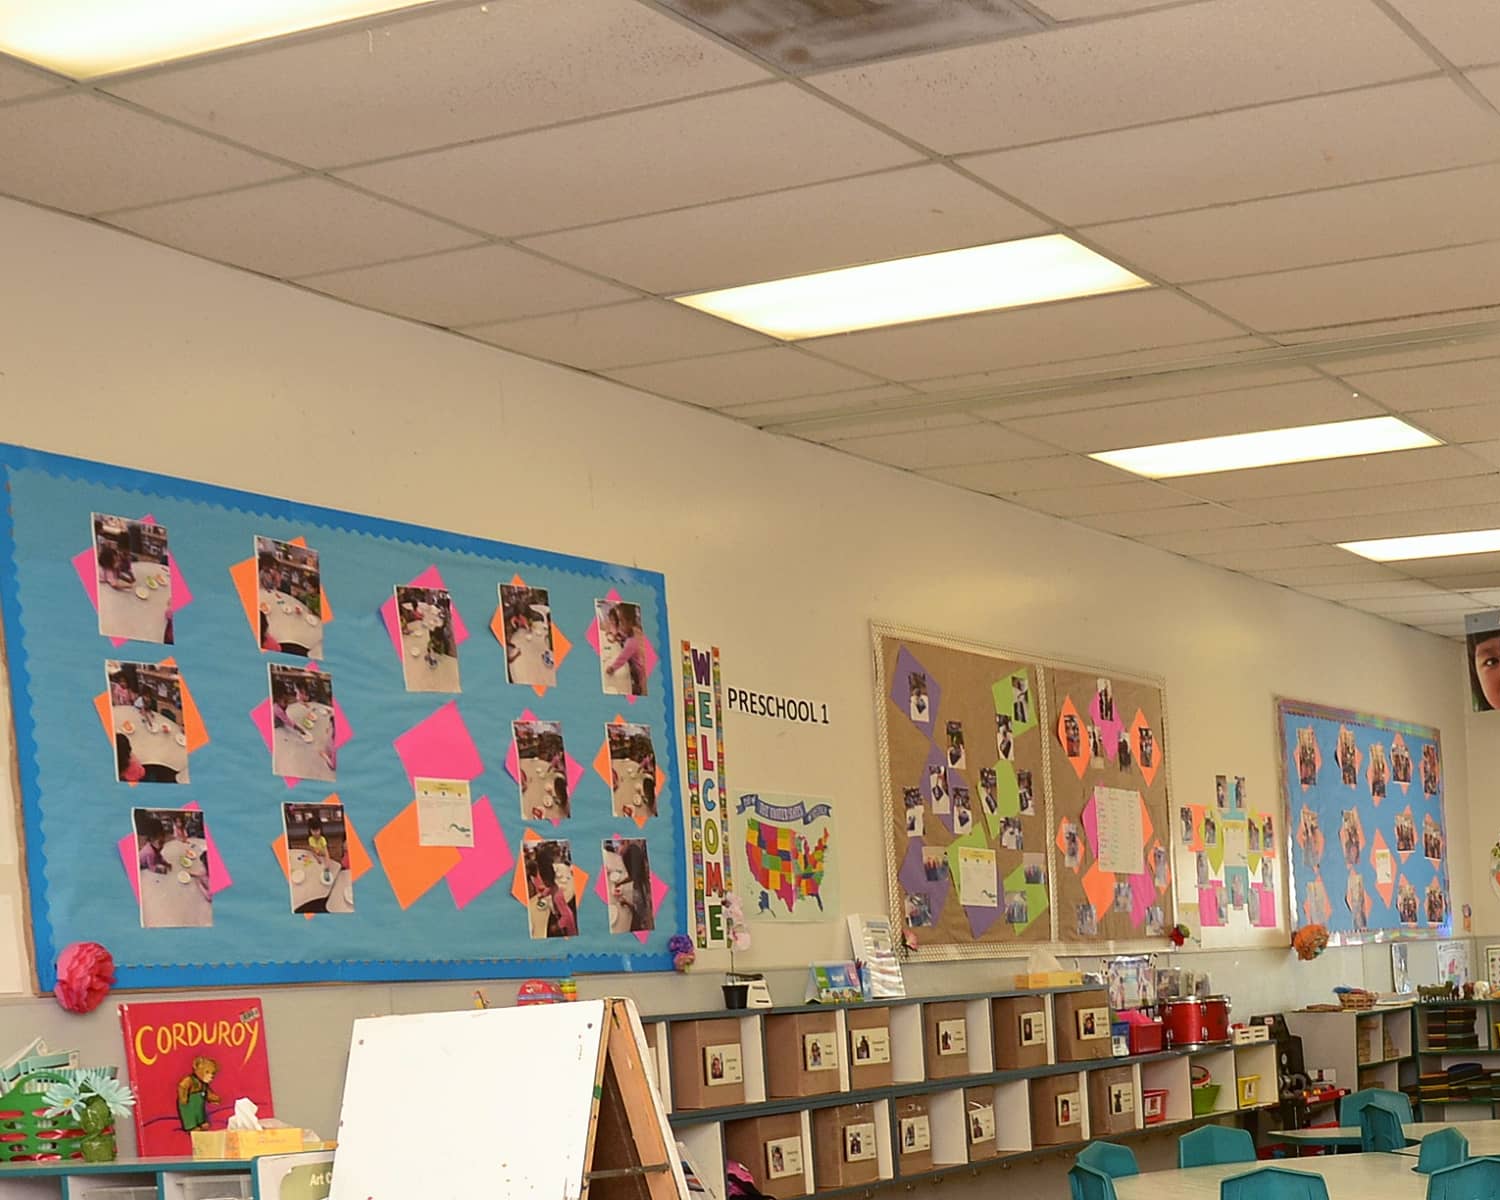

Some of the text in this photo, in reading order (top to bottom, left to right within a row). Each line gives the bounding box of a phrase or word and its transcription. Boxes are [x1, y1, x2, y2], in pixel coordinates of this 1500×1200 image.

[728, 687, 829, 724] PRESCHOOL 1
[691, 648, 724, 941] WELCOME
[134, 1021, 258, 1067] CORDUROY
[309, 1173, 325, 1187] Art
